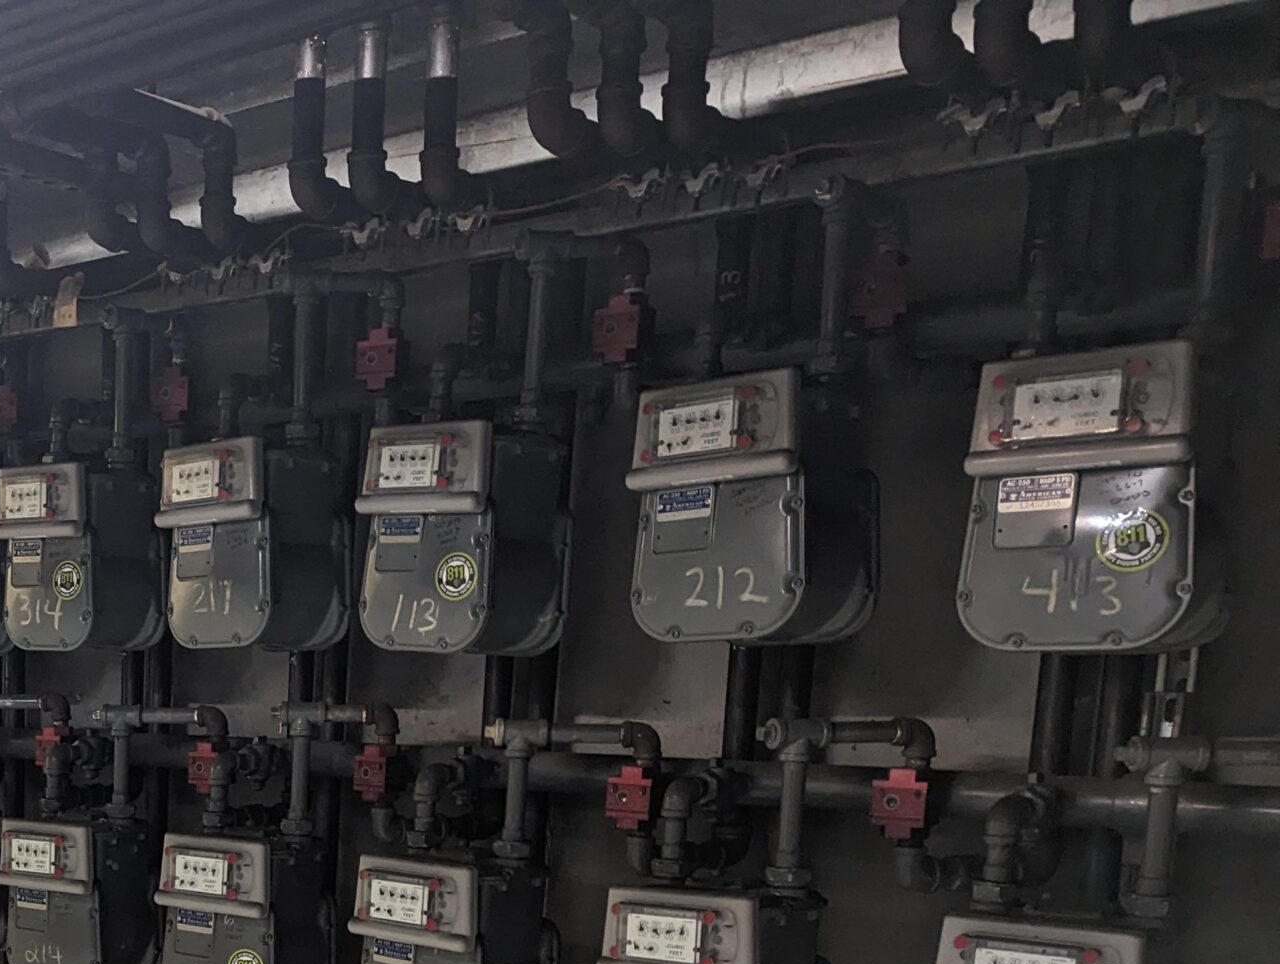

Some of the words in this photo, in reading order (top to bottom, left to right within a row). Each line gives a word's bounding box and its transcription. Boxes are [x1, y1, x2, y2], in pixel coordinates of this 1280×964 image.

[1116, 523, 1146, 546] 811
[60, 570, 73, 584] 811
[447, 565, 465, 581] 811
[684, 566, 769, 610] 212
[1021, 568, 1122, 616] 413
[19, 596, 63, 632] 314
[391, 593, 438, 633] 113
